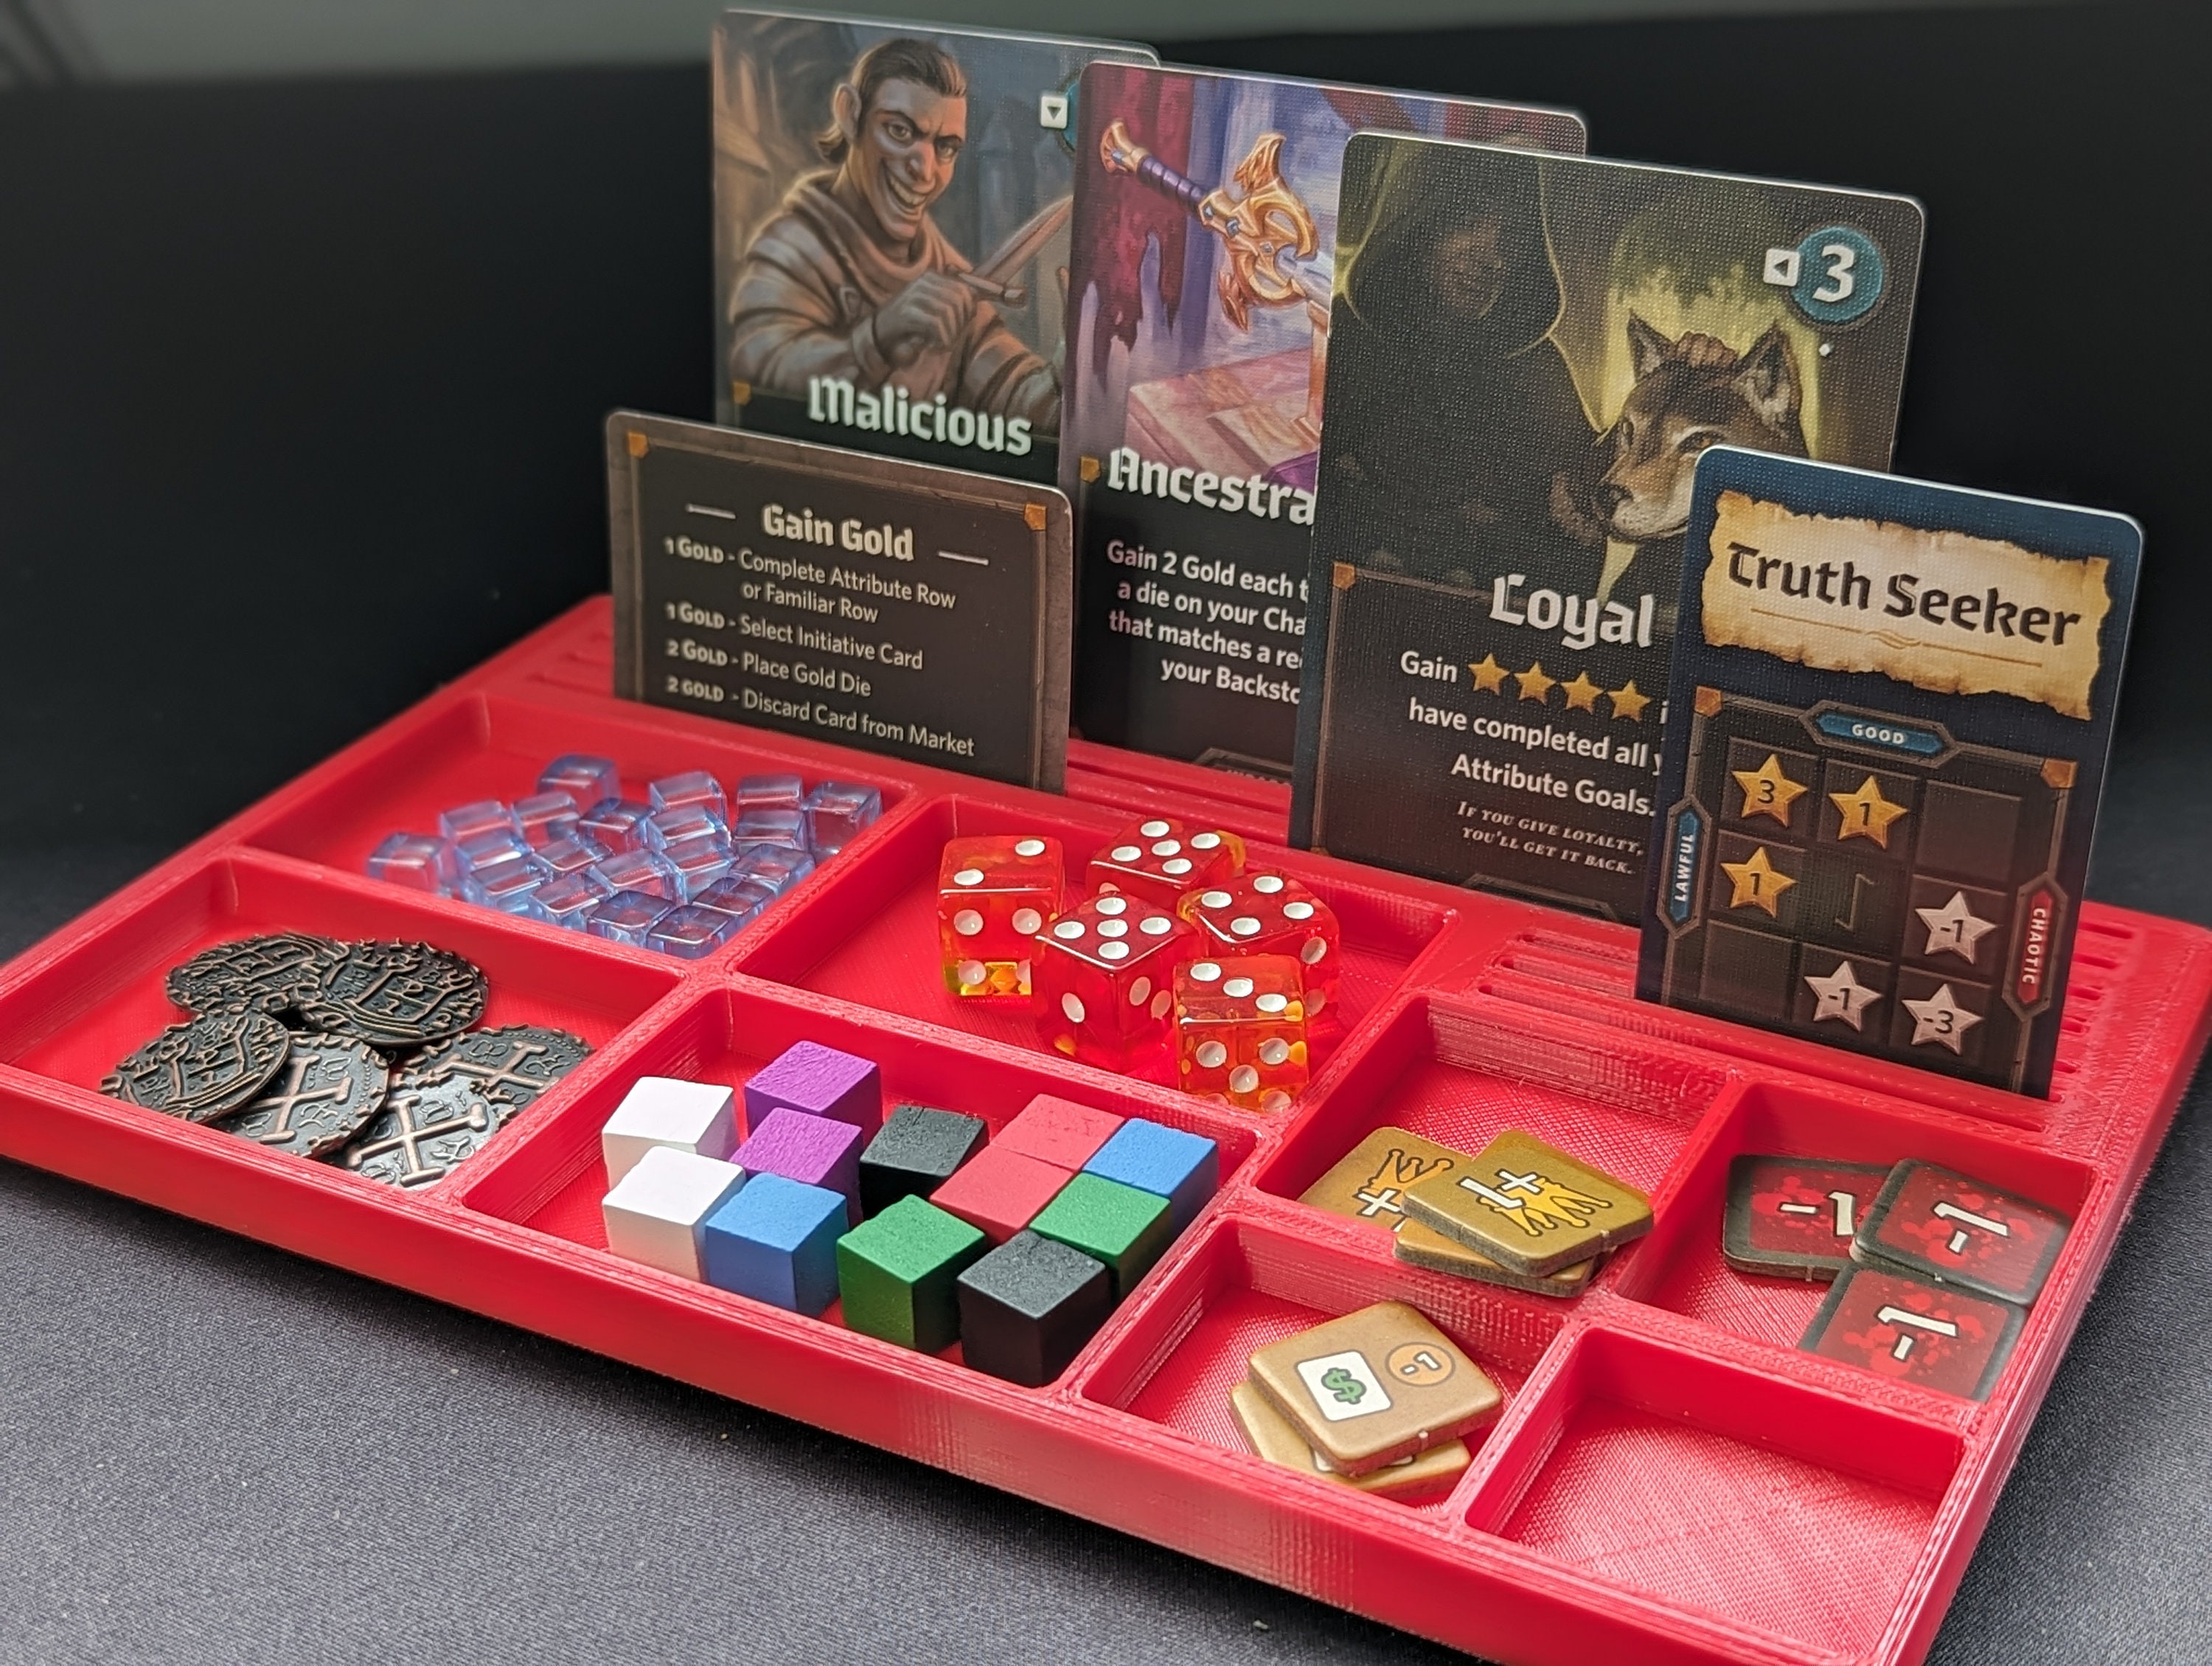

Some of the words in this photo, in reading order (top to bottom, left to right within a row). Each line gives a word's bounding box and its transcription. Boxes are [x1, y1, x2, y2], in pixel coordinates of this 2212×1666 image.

[1812, 244, 1855, 304] 3
[808, 375, 1033, 457] Malicious
[762, 502, 835, 547] Gain
[841, 518, 914, 562] Gold
[664, 537, 675, 555] 1
[740, 547, 826, 581] Complete
[830, 566, 913, 601] Attribute
[917, 582, 956, 609] Row
[1107, 539, 1158, 572] Gain
[1162, 550, 1178, 575] 2
[1182, 555, 1236, 587] Gold
[1239, 572, 1293, 598] each
[1726, 541, 1871, 612] Truth
[1882, 573, 2082, 648] Seeker
[742, 583, 762, 600] or
[765, 581, 836, 615] Familiar
[840, 597, 879, 624] Row
[1117, 580, 1131, 600] a
[1135, 580, 1170, 608] die
[1174, 593, 1203, 615] on
[1206, 599, 1259, 626] your
[1489, 573, 1655, 650] Loyal
[667, 602, 676, 620] 1
[740, 614, 793, 644] Select
[797, 625, 876, 661] Initiative
[879, 641, 923, 670] Card
[1108, 609, 1153, 639] that
[1158, 623, 1252, 660] matches
[1256, 645, 1270, 664] a
[667, 639, 679, 657] 2
[742, 650, 790, 680] Place
[793, 662, 836, 690] Gold
[840, 671, 872, 698] Die
[1160, 659, 1211, 685] your
[1401, 650, 1458, 684] Gain
[667, 676, 679, 693] 2
[742, 687, 810, 721] Discard
[814, 703, 858, 731] Card
[861, 712, 904, 742] from
[908, 723, 975, 757] Market
[1408, 696, 1467, 731] have
[1473, 716, 1611, 760] completed
[1614, 741, 1650, 768] all
[1851, 723, 1906, 746] GOOD
[1450, 752, 1569, 799] Attribute
[1574, 778, 1657, 817] Goals.
[1758, 778, 1776, 805] 3
[1481, 809, 1515, 826] YOU
[1517, 818, 1559, 836] GIVE
[1860, 801, 1871, 827] 1
[1523, 841, 1557, 858] GET
[1560, 849, 1581, 863] IT
[1673, 832, 1695, 903] LAWFUL
[1750, 870, 1761, 895] 1
[1939, 917, 1964, 944] -1
[2021, 906, 2047, 986] CHAOTIC
[1827, 987, 1852, 1012] -1
[1921, 1008, 1954, 1035] -3
[1778, 1190, 1857, 1238] -1
[1933, 1201, 2010, 1254] -1
[1877, 1305, 1959, 1362] -1
[1400, 1350, 1442, 1377] -1
